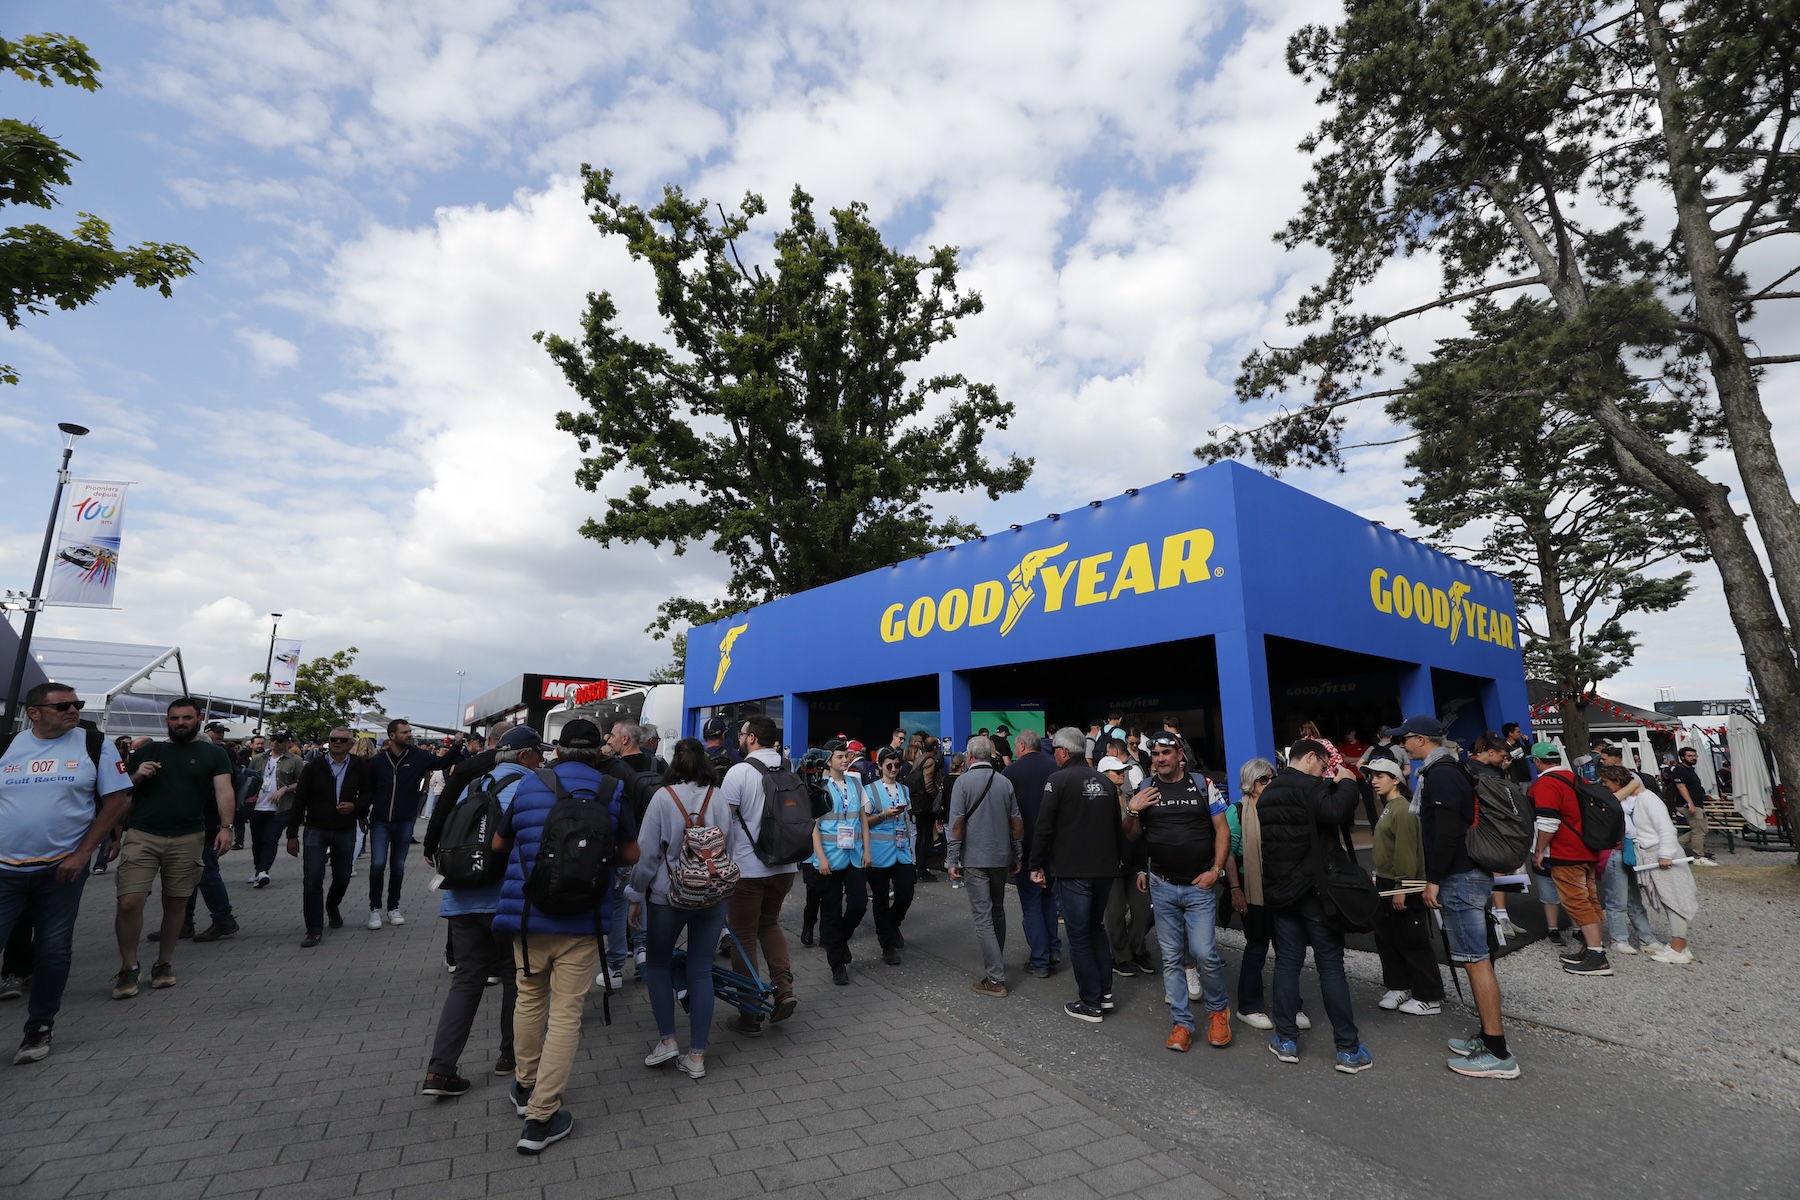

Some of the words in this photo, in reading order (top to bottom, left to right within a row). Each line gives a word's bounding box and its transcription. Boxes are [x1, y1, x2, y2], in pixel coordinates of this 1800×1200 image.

[85, 484, 119, 492] Pionniers
[72, 497, 116, 522] 100
[880, 528, 1214, 643] GOODYEAR
[1370, 568, 1514, 650] GOODYEAR
[1286, 682, 1357, 696] GOODYEAR
[809, 700, 841, 711] AGLE
[1109, 698, 1160, 709] GOODYEAR
[31, 760, 55, 773] 007
[5, 778, 30, 786] Gulf
[34, 775, 75, 785] Racing
[1086, 783, 1101, 792] SFS
